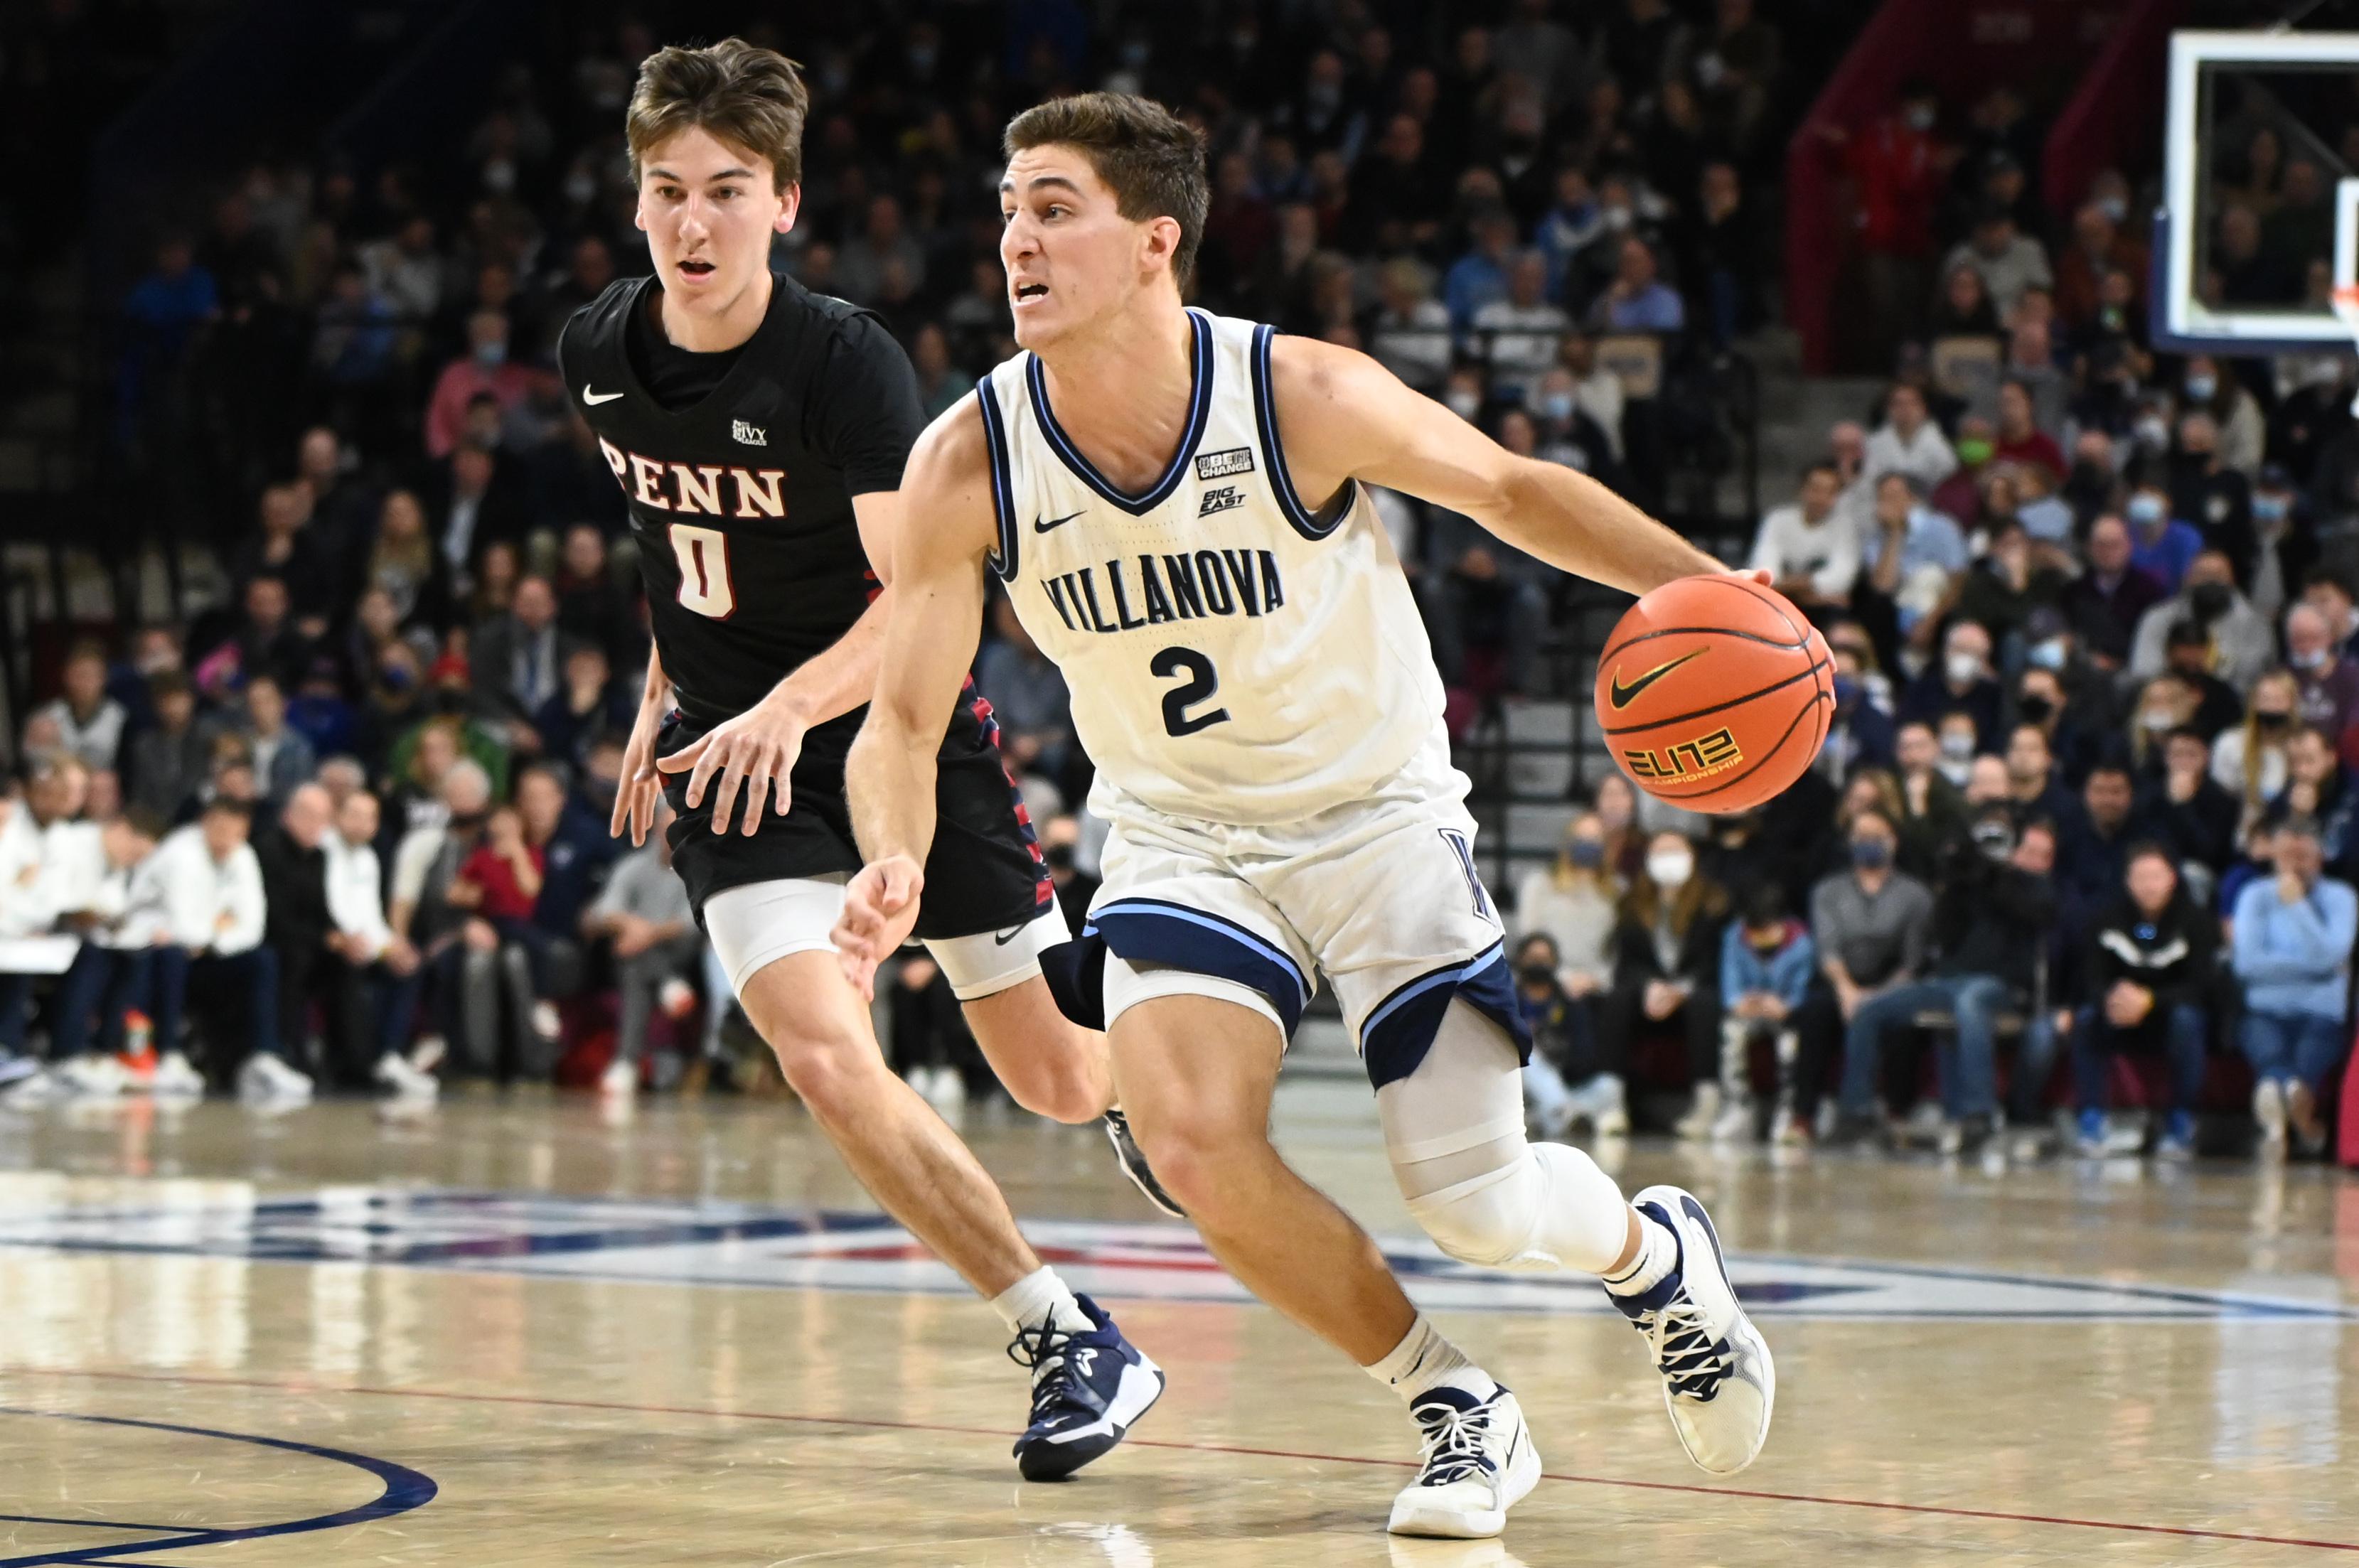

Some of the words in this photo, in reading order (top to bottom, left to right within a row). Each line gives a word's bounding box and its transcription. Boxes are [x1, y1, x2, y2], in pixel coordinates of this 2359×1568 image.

[742, 427, 766, 441] IVY
[599, 434, 787, 519] PENN
[1200, 461, 1252, 478] CHANGE
[1203, 485, 1236, 502] BIG
[1199, 494, 1247, 513] EAST
[667, 522, 738, 621] 0
[1039, 548, 1285, 633] VILLANOVA
[1150, 645, 1231, 737] 2
[1624, 726, 1740, 778] ELITE
